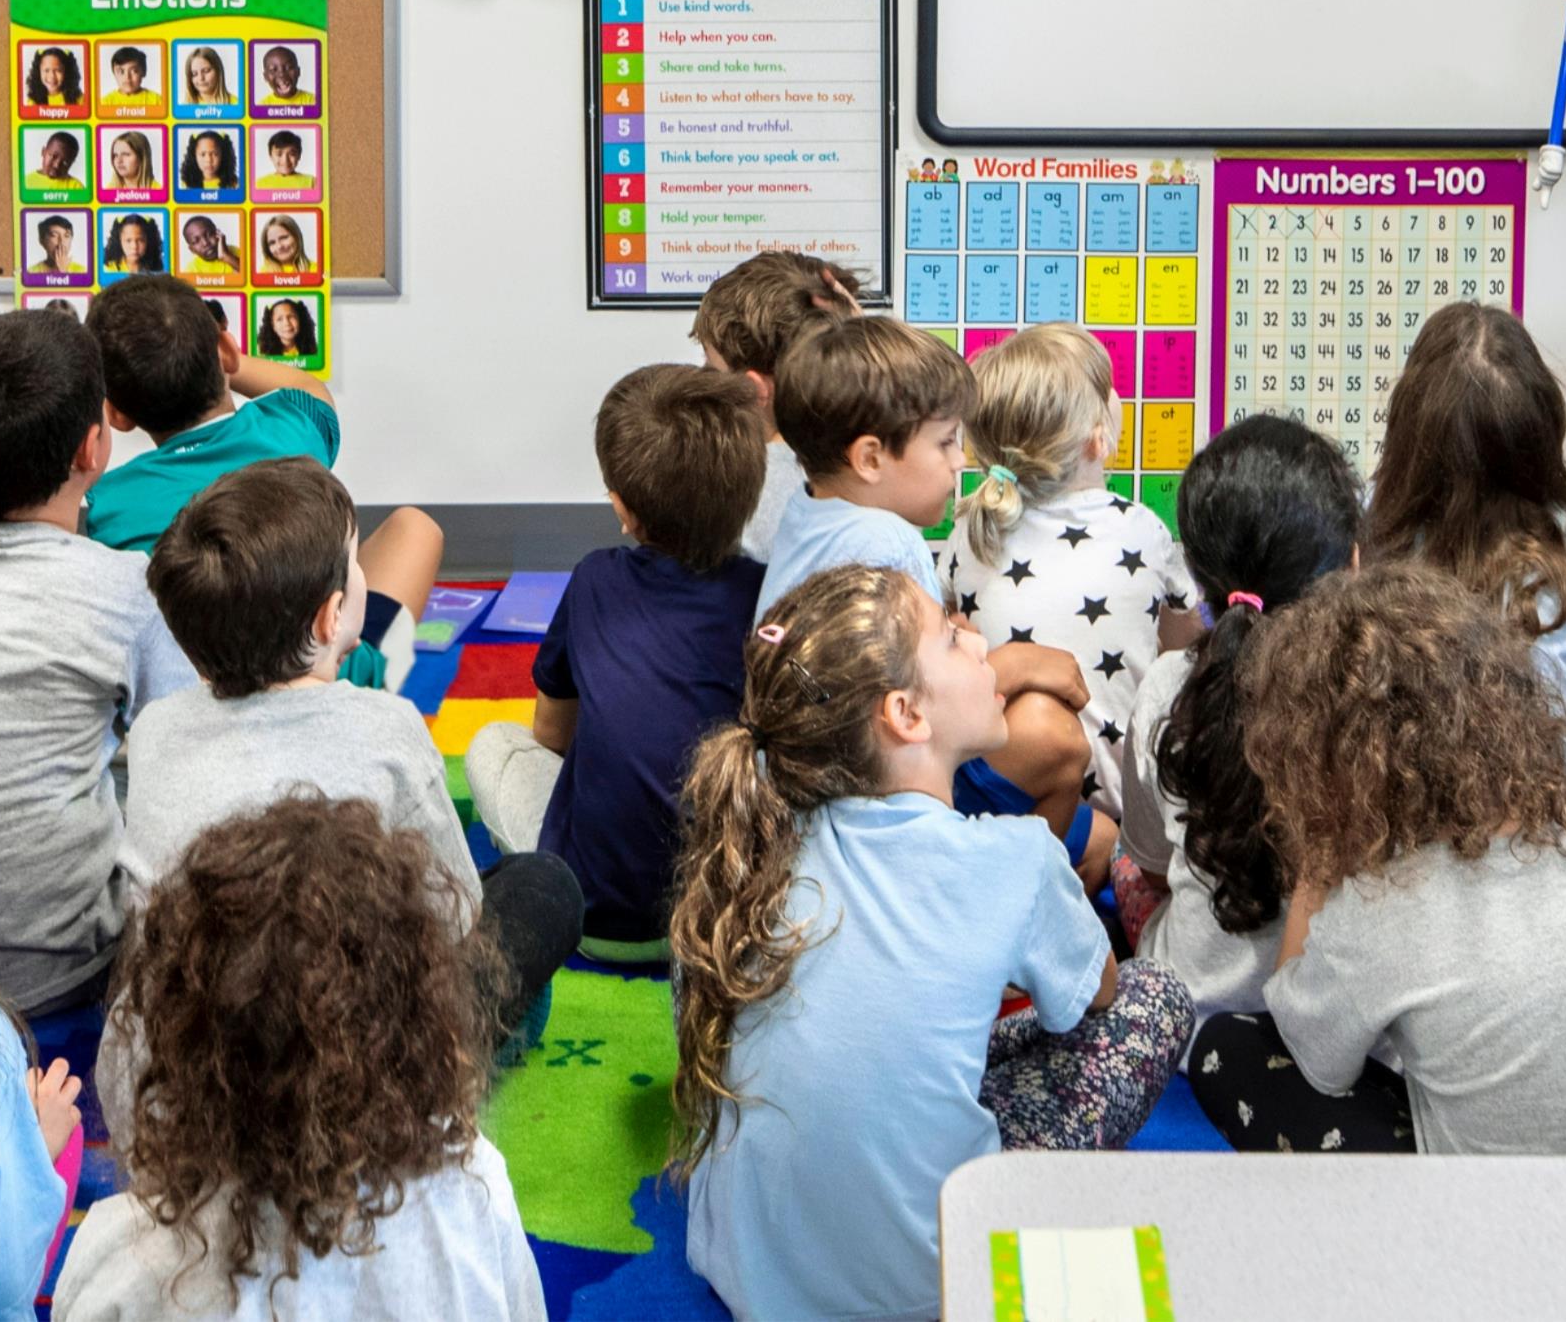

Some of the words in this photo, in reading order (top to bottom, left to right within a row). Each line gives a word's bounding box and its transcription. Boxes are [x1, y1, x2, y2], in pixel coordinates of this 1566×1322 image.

[659, 2, 680, 13] Use
[684, 1, 711, 13] kind
[714, 2, 754, 13] words.
[618, 29, 628, 46] 2
[659, 31, 687, 44] Help
[690, 31, 723, 43] when
[727, 33, 749, 45] you
[752, 32, 776, 42] can.
[617, 89, 629, 106] 4
[660, 91, 693, 103] Listen
[697, 91, 708, 103] to
[711, 91, 740, 103] what
[744, 91, 780, 103] others
[785, 91, 812, 102] have
[817, 92, 828, 102] to
[832, 93, 855, 106] say.
[39, 106, 69, 118] happy
[116, 105, 146, 117] afraid
[195, 105, 222, 118] guilty
[268, 106, 303, 117] excited
[974, 156, 1036, 178] Word
[1041, 156, 1137, 180] Families
[1256, 167, 1394, 195] Numbers
[660, 181, 723, 193] Remember
[727, 184, 753, 196] your
[757, 183, 811, 193] manners.
[923, 188, 942, 202] ab
[984, 188, 1003, 201] ad
[1164, 188, 1181, 201] an
[115, 189, 150, 202] jealous
[201, 190, 218, 201] sad
[272, 190, 300, 201] proud
[1044, 191, 1062, 207] ag
[1102, 191, 1125, 203] am
[661, 211, 688, 223] Hold
[693, 214, 718, 226] your
[723, 212, 766, 226] temper.
[1103, 261, 1120, 275] ed
[46, 276, 69, 286] tired
[1348, 279, 1363, 296] 25
